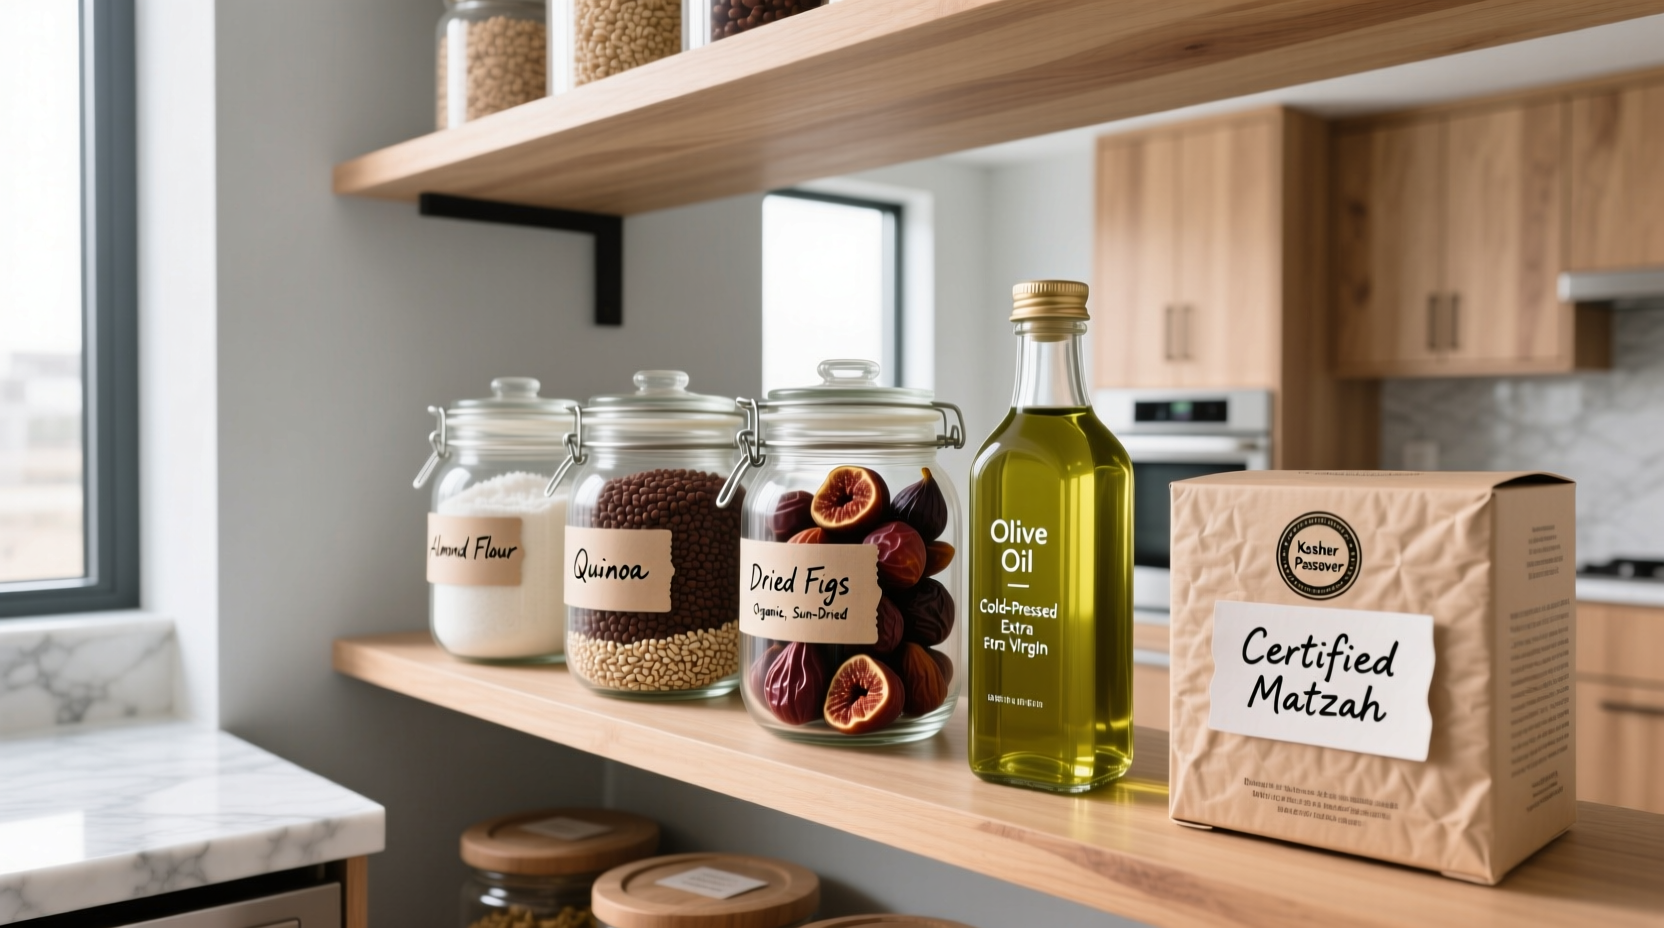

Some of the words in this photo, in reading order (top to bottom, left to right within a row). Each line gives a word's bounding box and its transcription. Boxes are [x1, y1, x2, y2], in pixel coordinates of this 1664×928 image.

[990, 518, 1048, 546] Olive
[474, 535, 518, 560] Flour
[1001, 548, 1033, 573] Oil
[573, 548, 650, 583] Quinoa
[750, 563, 797, 593] Dried
[805, 566, 849, 606] Figs
[792, 606, 848, 620] Sun-Dried
[979, 598, 1058, 619] Cold-Pressed
[1241, 627, 1399, 682] Certified
[1246, 675, 1387, 723] Matzah
